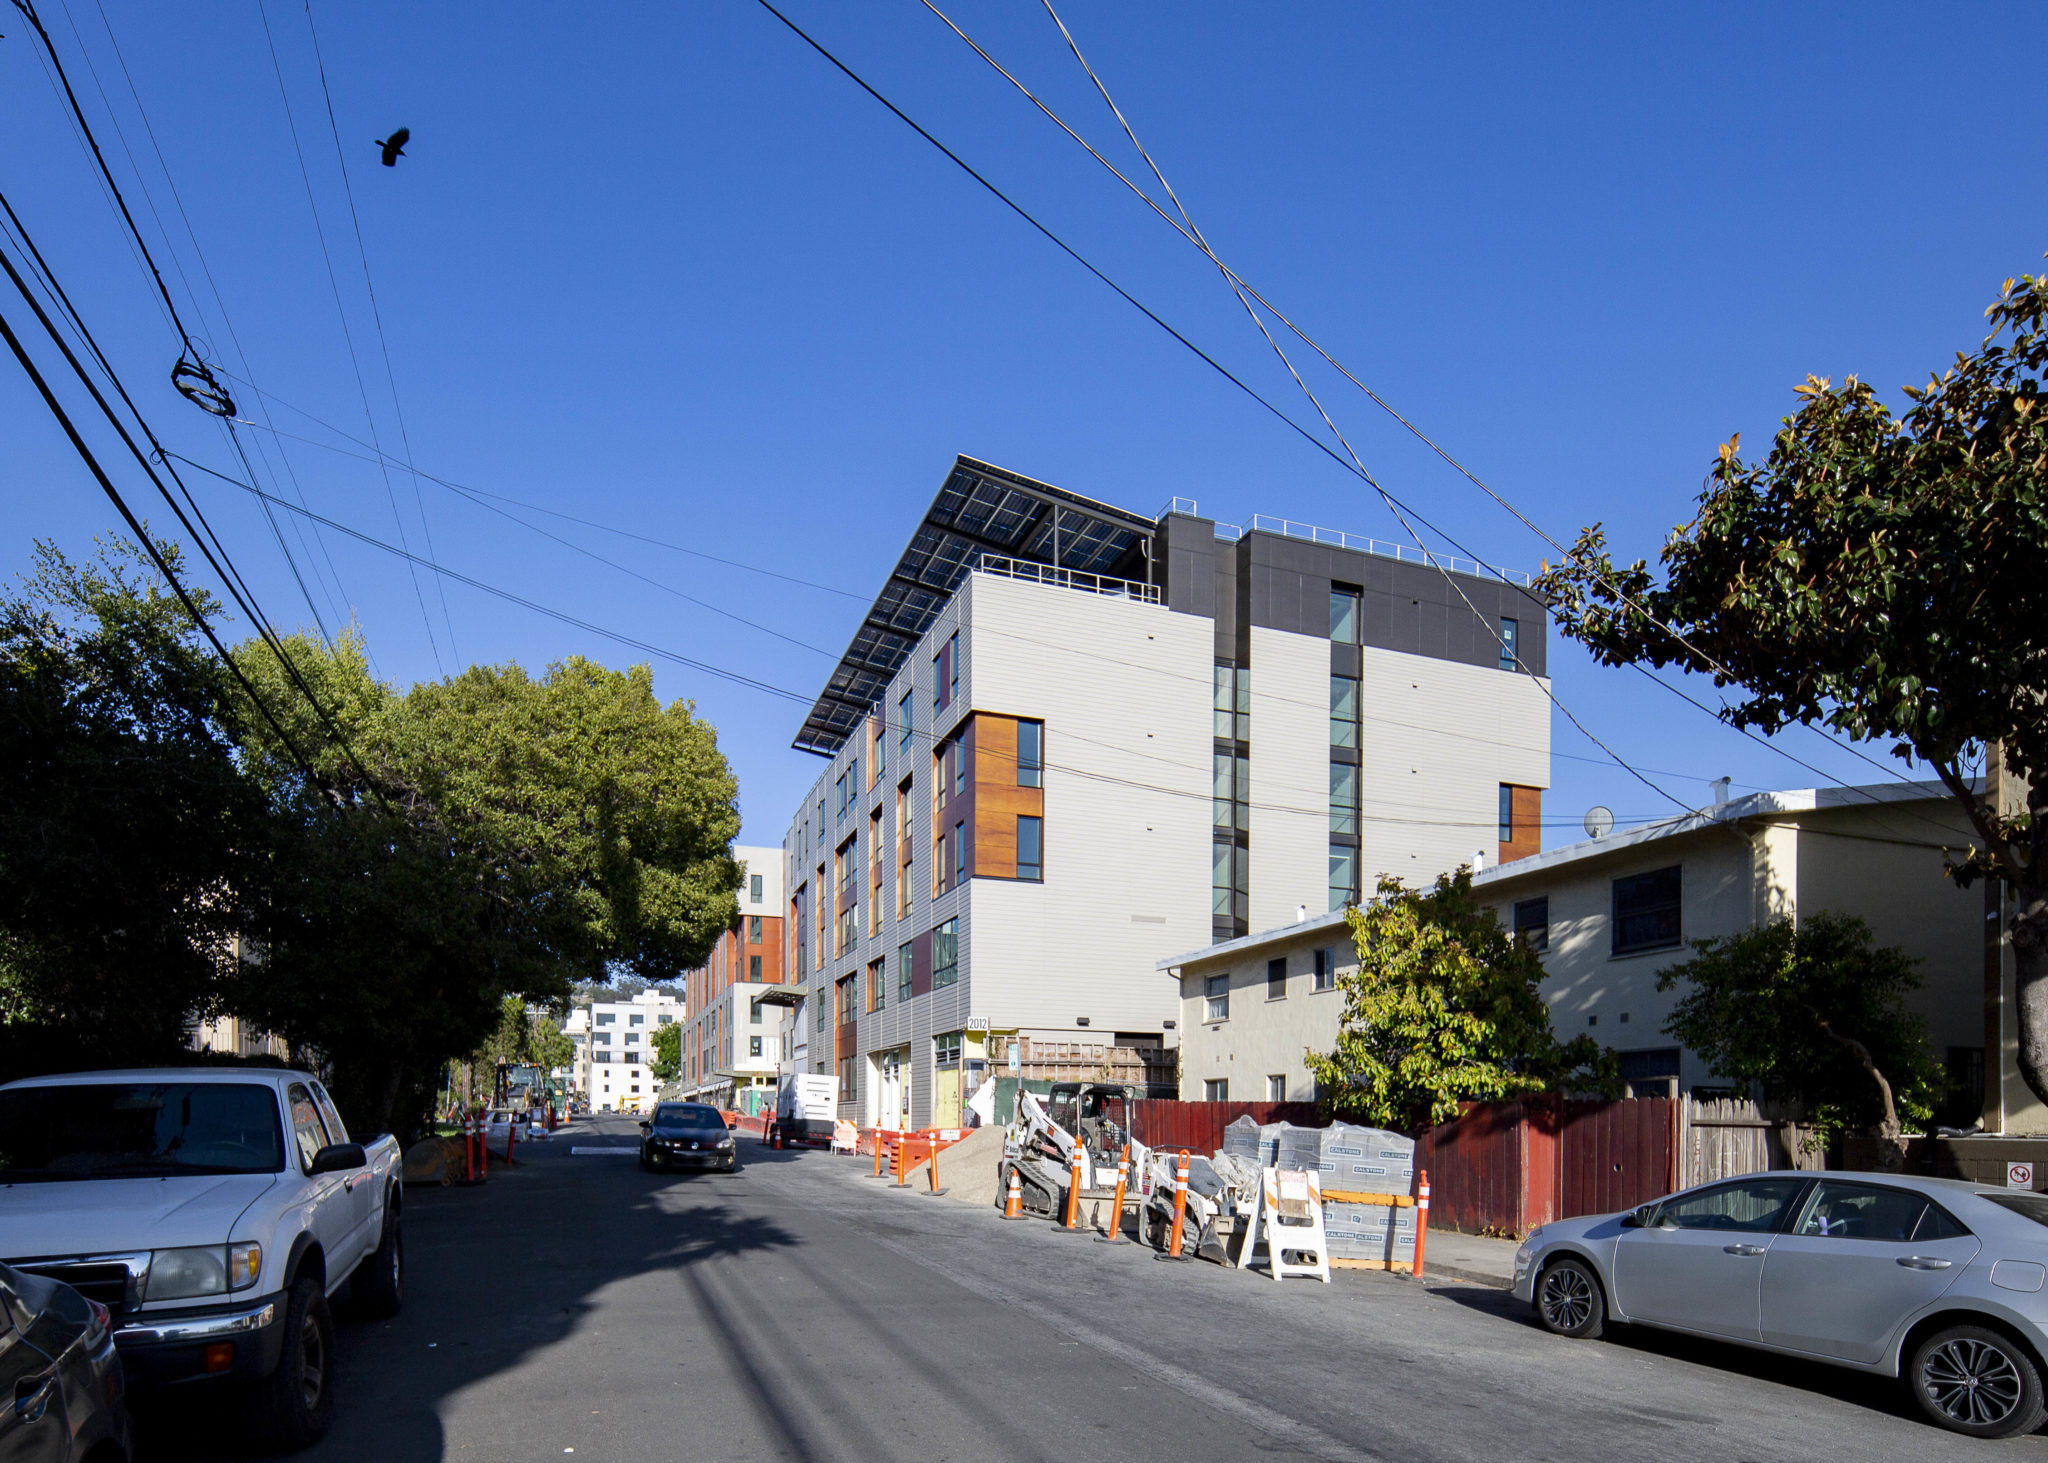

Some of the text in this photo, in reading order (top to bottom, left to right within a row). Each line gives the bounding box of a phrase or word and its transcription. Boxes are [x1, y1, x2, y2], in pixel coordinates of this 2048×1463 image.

[968, 1018, 987, 1029] 2012
[1330, 1147, 1360, 1155] CALSTONE
[1380, 1218, 1407, 1226] CALONE
